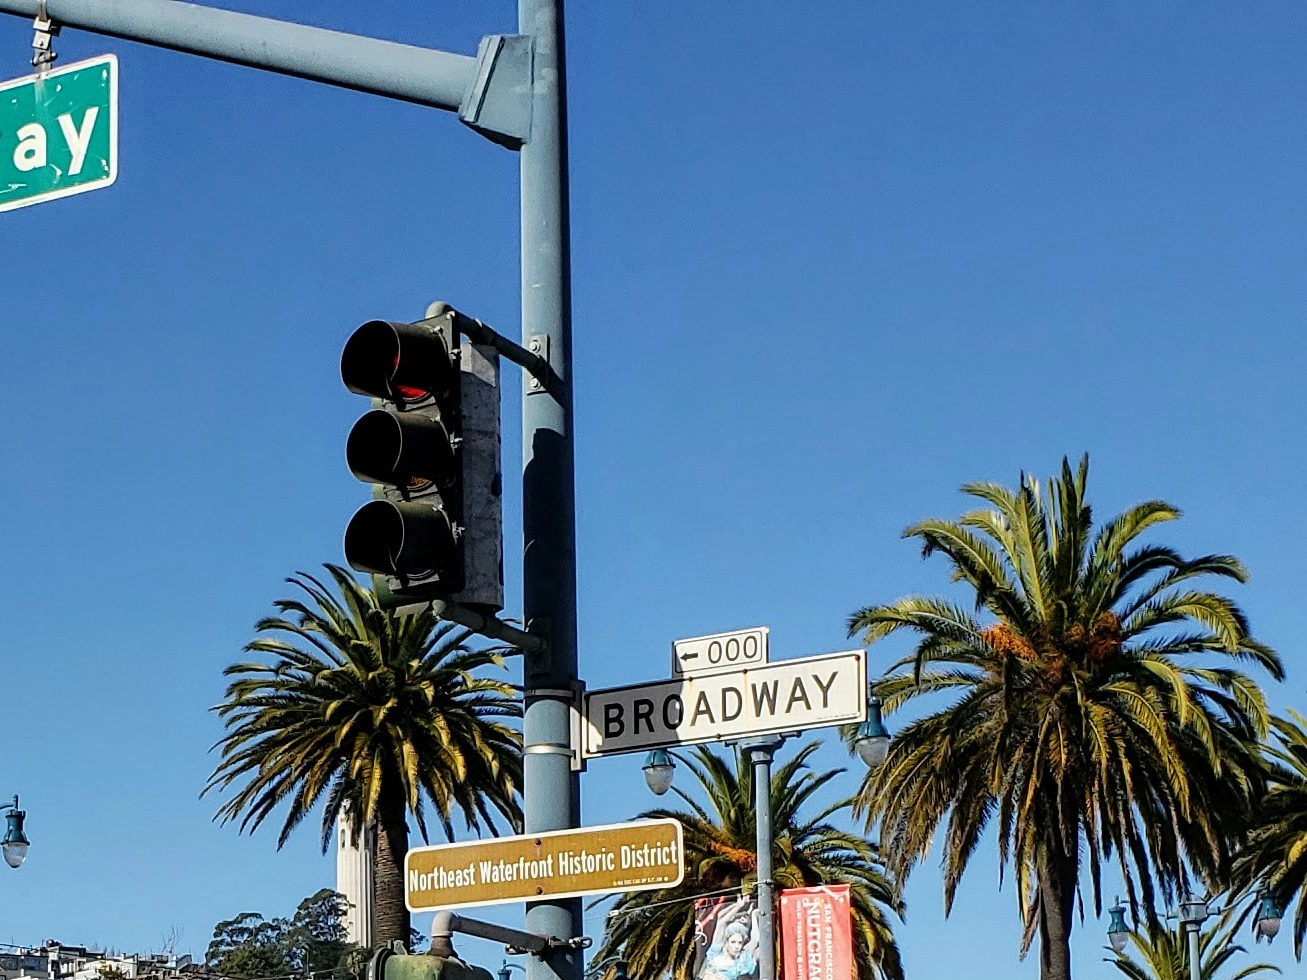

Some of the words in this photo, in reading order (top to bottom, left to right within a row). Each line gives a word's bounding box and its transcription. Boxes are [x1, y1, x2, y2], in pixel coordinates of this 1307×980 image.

[707, 635, 758, 662] 000
[603, 671, 838, 739] BROADWAY
[409, 862, 476, 893] Northeast
[479, 854, 554, 884] Waterfront
[559, 848, 615, 876] Historic
[621, 840, 678, 869] District
[825, 927, 833, 980] FRANCISCO
